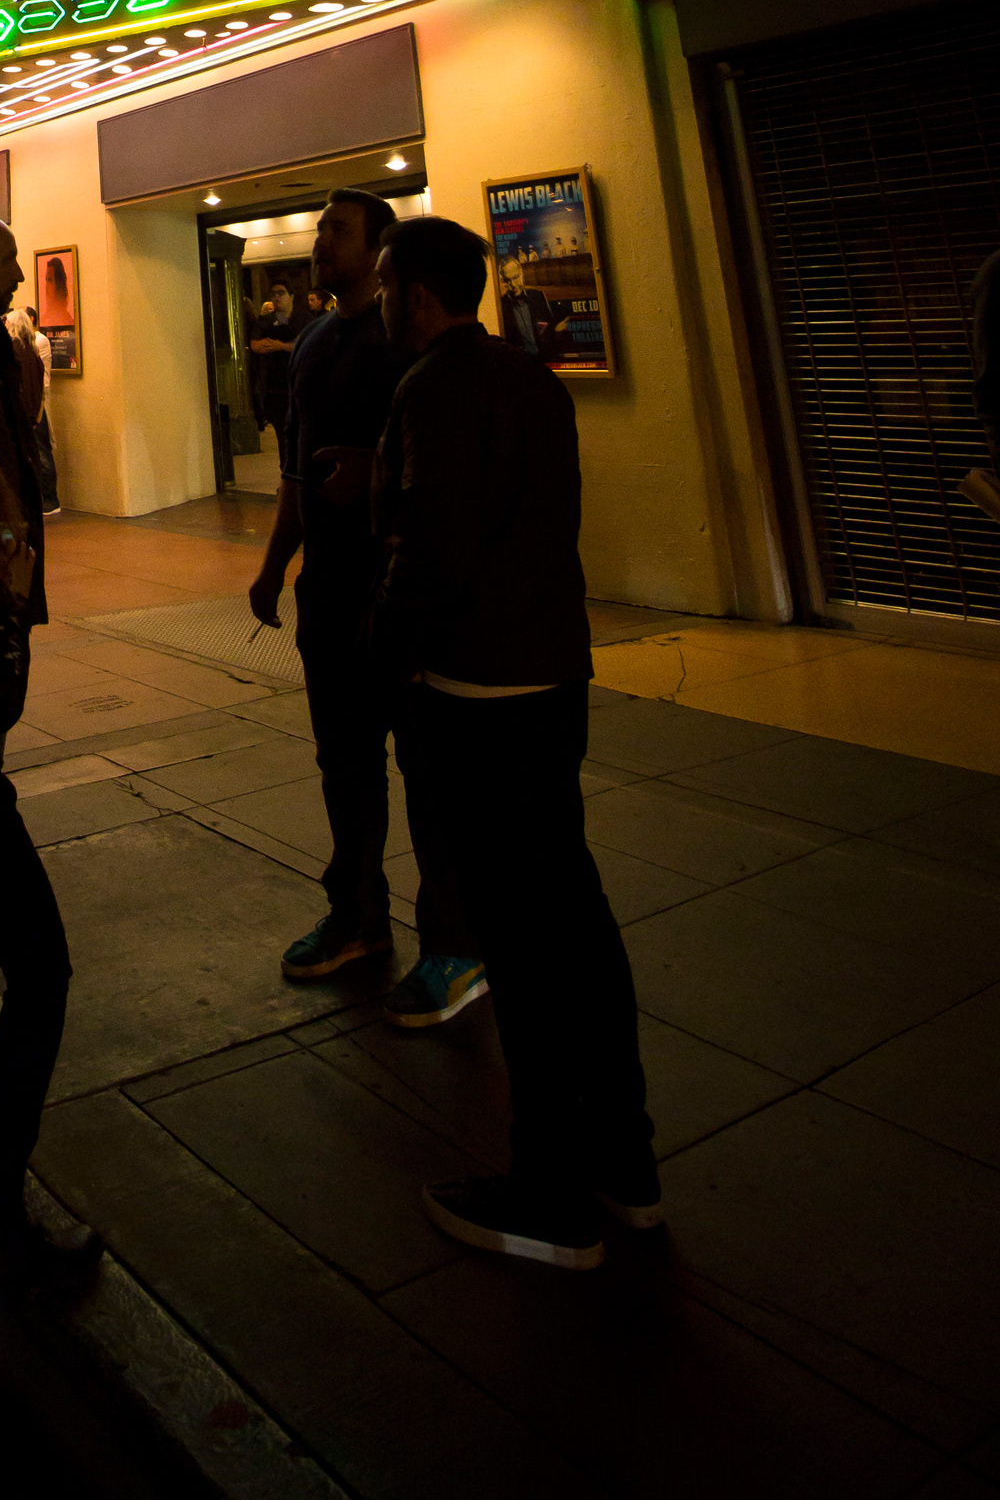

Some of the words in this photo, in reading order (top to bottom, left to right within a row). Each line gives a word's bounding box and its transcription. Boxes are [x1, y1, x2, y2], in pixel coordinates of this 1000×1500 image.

[490, 187, 534, 214] LEWIS
[535, 180, 583, 208] BLACK
[572, 301, 587, 313] DEC
